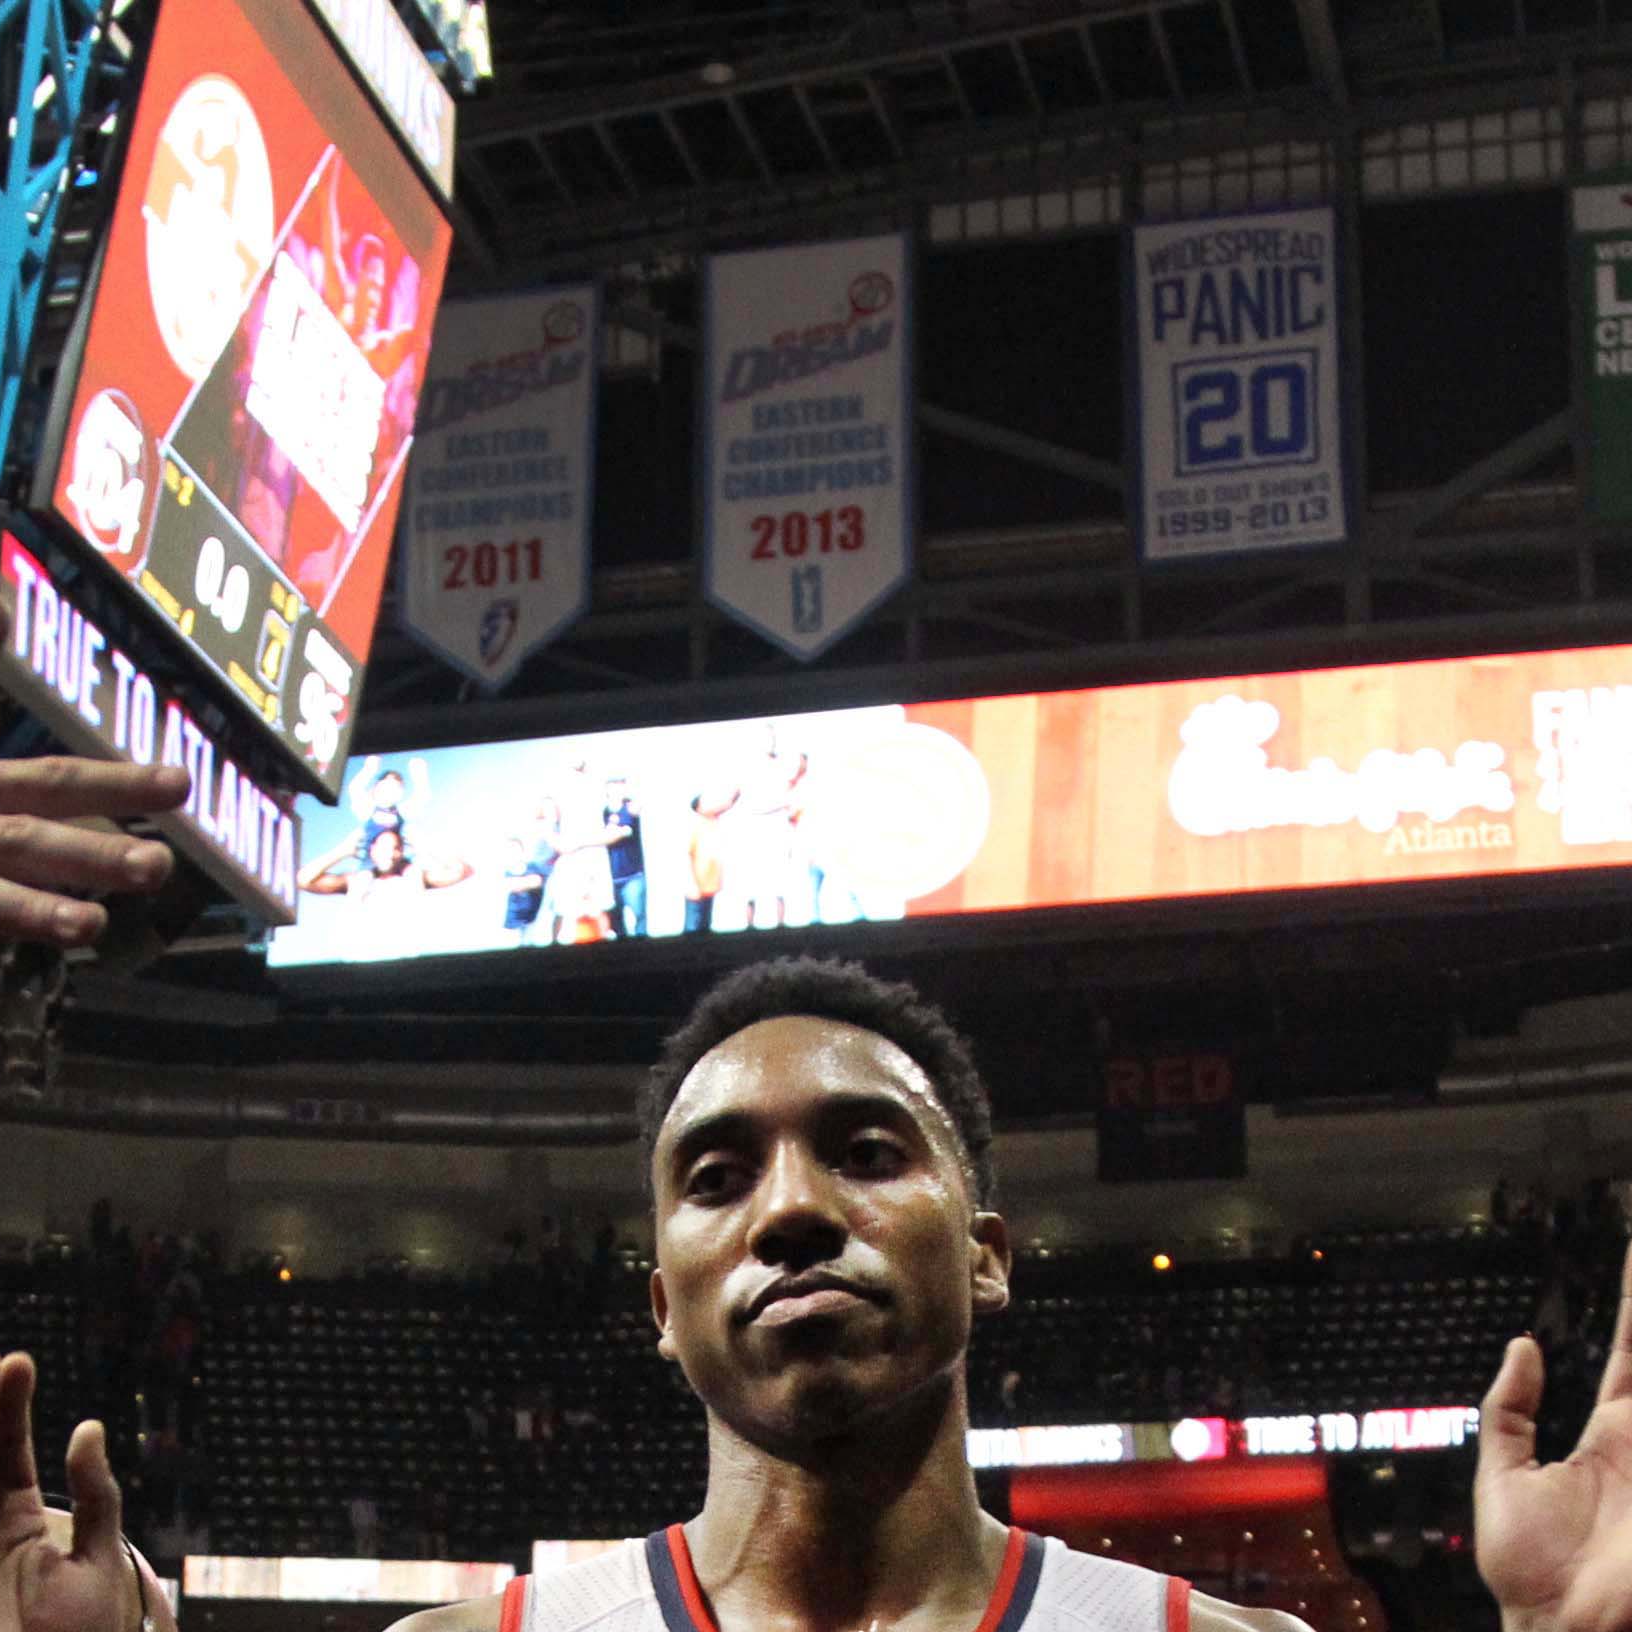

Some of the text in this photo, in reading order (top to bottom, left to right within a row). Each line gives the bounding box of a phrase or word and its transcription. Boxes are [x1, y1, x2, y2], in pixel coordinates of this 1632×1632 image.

[1147, 227, 1324, 276] WIDESPREAD
[1152, 265, 1324, 344] PANIC
[1185, 363, 1309, 465] 20
[729, 424, 888, 464] CONFERENCE
[418, 456, 569, 493] CONFERENCE
[723, 458, 893, 502] CHAMPIONS
[1213, 480, 1252, 503] OUT
[1259, 472, 1330, 498] SHOWS
[415, 491, 574, 532] CHAMPIONS
[751, 506, 865, 560] 2013
[444, 538, 542, 590] 2011
[13, 553, 296, 906] TRUE TO ATLANTA
[1384, 820, 1513, 856] Atlanta
[1105, 1055, 1233, 1107] RED
[1318, 1413, 1358, 1452] TO
